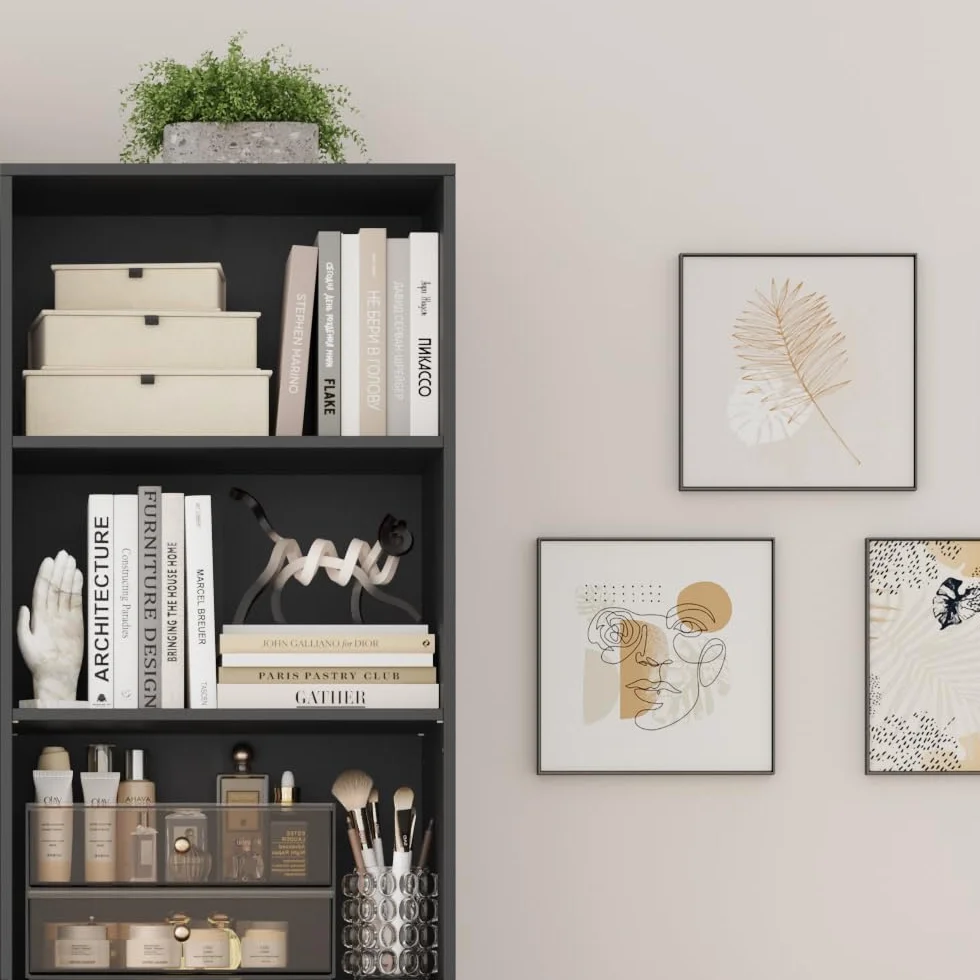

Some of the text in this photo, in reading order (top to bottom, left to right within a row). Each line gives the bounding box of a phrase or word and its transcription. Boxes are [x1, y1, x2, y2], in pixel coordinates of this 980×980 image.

[367, 290, 381, 308] НЕ
[289, 293, 307, 395] STEPHEN MARINO
[367, 310, 381, 344] БЕРИ
[367, 347, 381, 356] В
[417, 337, 432, 398] ПИКАССО
[323, 378, 336, 416] FLAKE
[367, 358, 381, 412] ГОЛОВУ
[93, 516, 110, 682] ARCHITECTURE
[143, 491, 157, 708] FURNITURE DESIGN
[167, 542, 178, 662] BRINGING THE HOUSE HOME
[196, 568, 206, 645] MARCEL BREUER
[263, 638, 379, 648] JOHN GALLIANO for DIOR
[258, 672, 400, 680] PARIS PASTRY CLUB
[295, 690, 366, 705] GATHER
